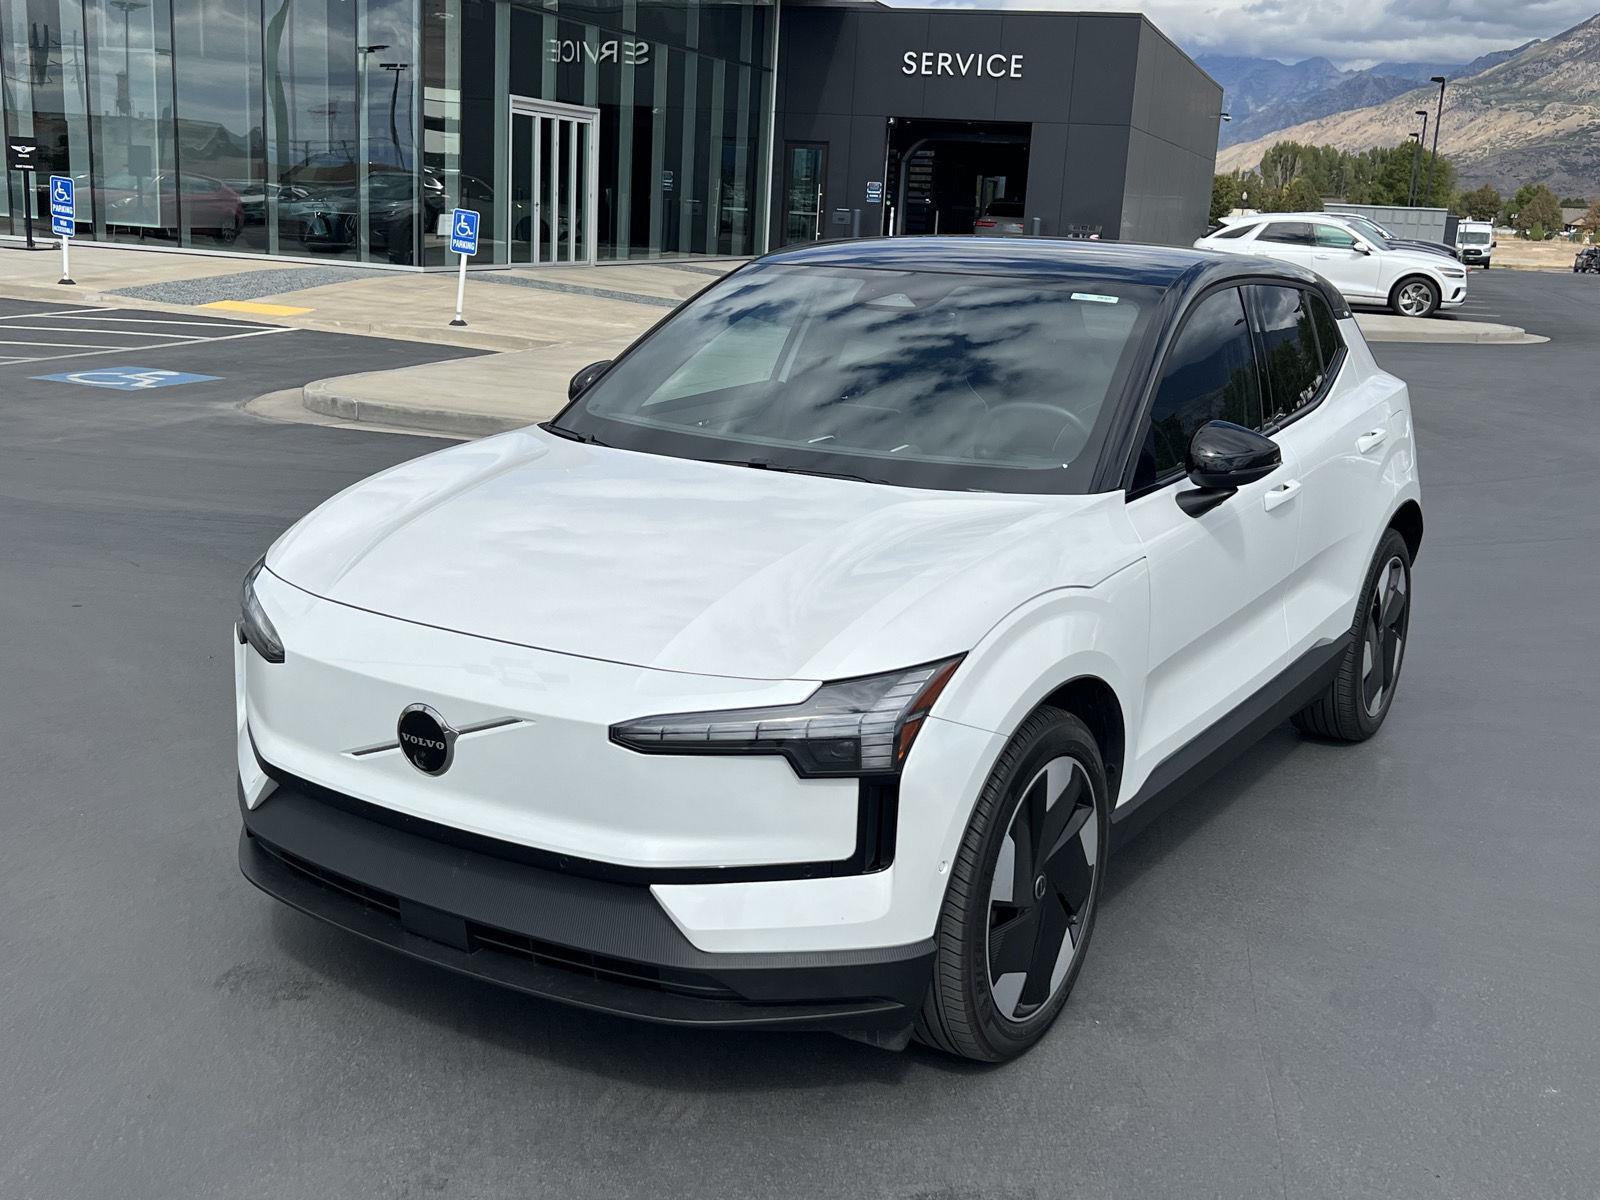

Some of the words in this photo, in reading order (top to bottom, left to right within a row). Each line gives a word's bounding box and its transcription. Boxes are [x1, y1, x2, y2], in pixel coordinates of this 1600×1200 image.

[902, 51, 1024, 78] SERVICE
[52, 203, 74, 214] PARKING
[452, 238, 476, 251] PARKING
[401, 732, 445, 750] VOLVO
